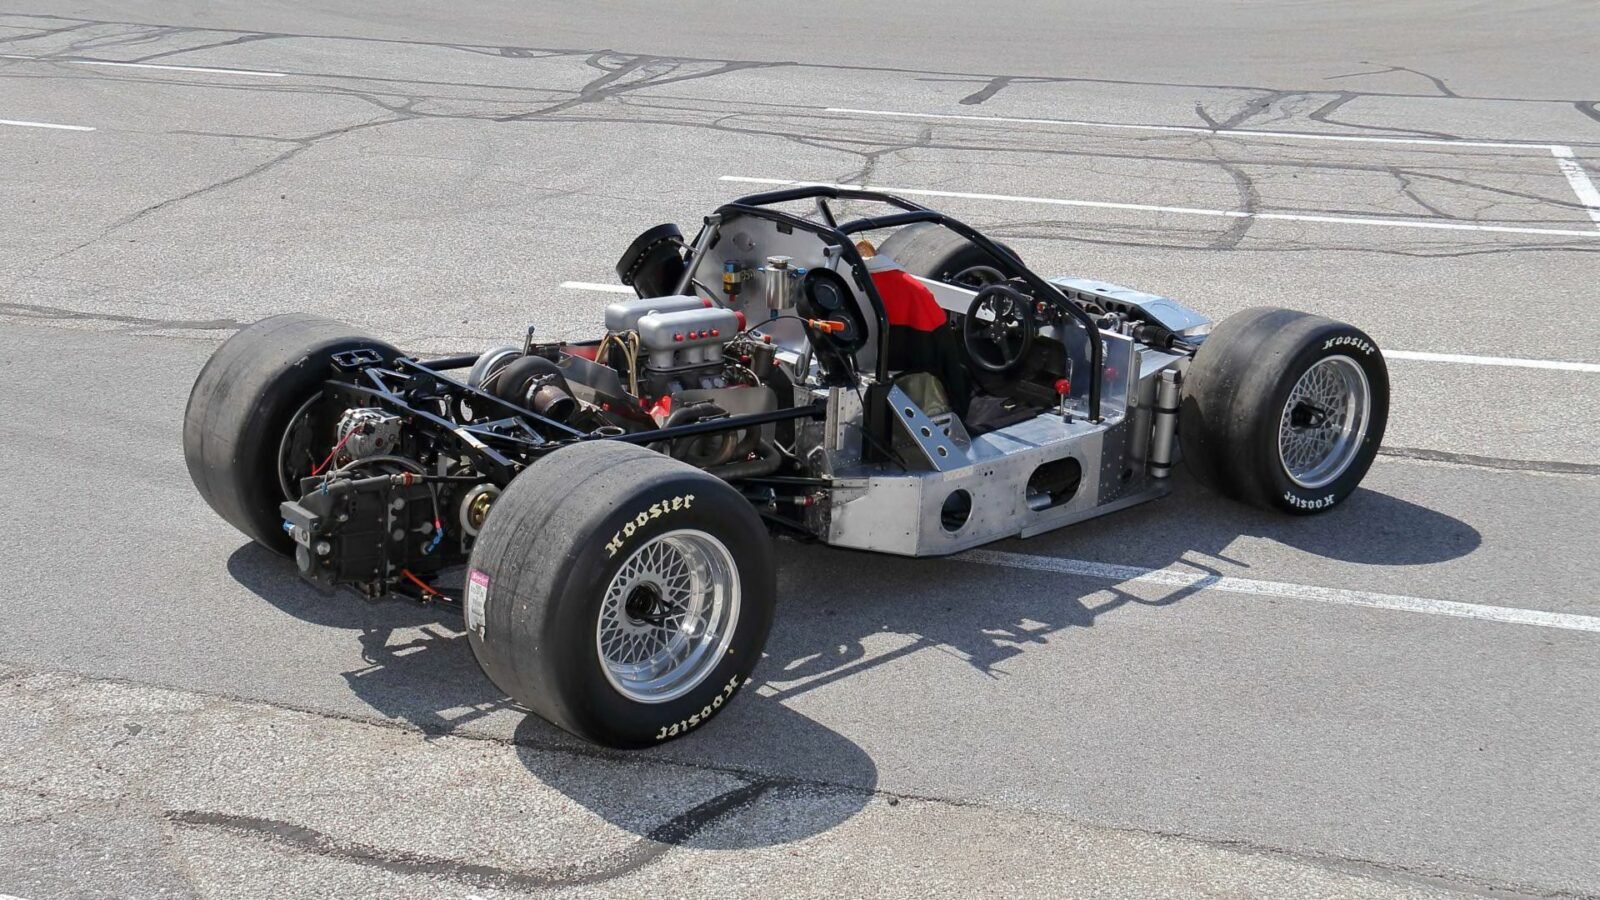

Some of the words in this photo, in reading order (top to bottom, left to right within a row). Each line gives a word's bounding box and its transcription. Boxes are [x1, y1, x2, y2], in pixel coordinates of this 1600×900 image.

[1322, 336, 1375, 356] Hoosier
[1284, 491, 1335, 509] Hoosier
[605, 494, 695, 559] Hoosier
[656, 674, 739, 740] Hoosier
